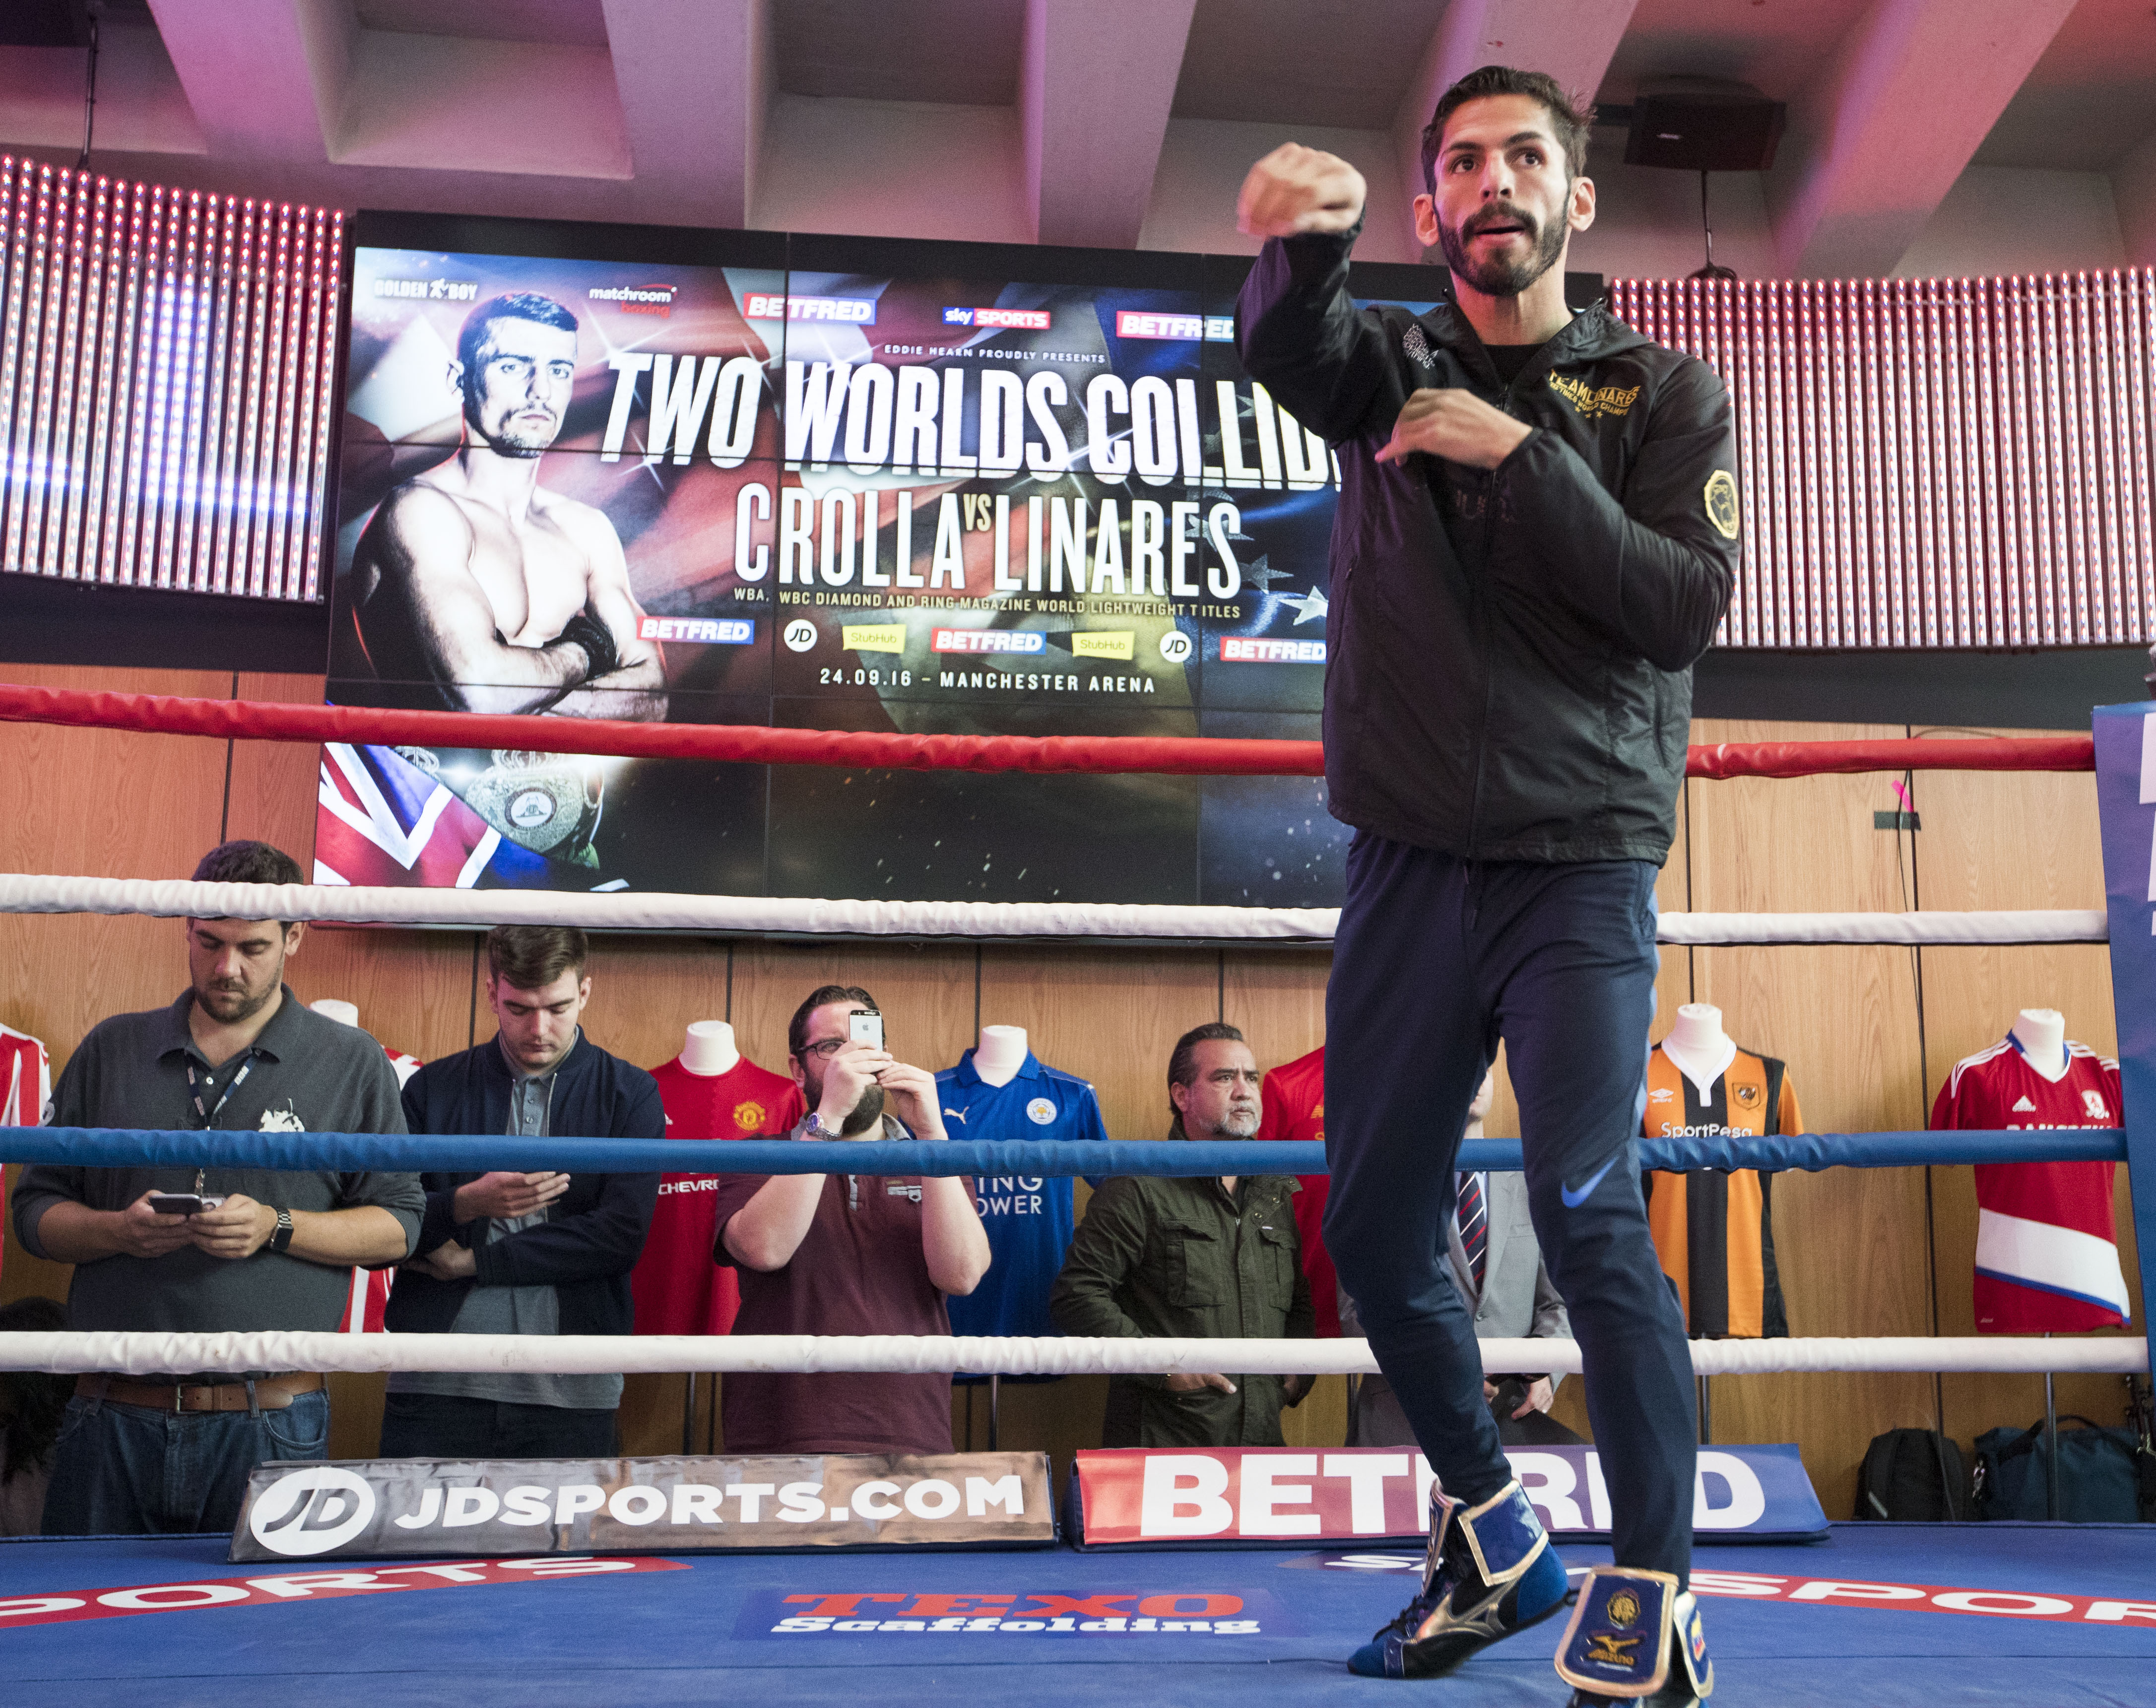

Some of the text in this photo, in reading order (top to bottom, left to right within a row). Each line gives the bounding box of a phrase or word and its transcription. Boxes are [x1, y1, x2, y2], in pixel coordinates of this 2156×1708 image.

[448, 283, 478, 300] BOY
[589, 286, 672, 303] matchroom
[748, 296, 872, 321] BETFRED
[945, 308, 1047, 327] sky SPORTS
[884, 345, 1106, 363] EDDIE HEARN PROUDLY PRESENTS
[600, 352, 1342, 492] TWO WORLDS COLLID
[734, 483, 1241, 599] CROLLA VS LINARES
[779, 591, 810, 604] WBC
[816, 592, 882, 607] DIAMOND
[887, 595, 915, 608] AND
[921, 596, 954, 609] RING
[960, 597, 1031, 611] MAGAZINE
[1037, 599, 1085, 613] WORLD
[1091, 601, 1185, 616] LIGHTWEIGHT
[1191, 604, 1240, 618] TITLES
[640, 618, 751, 642] BETFRED
[789, 625, 812, 643] JD
[850, 631, 897, 644] StubHub
[936, 630, 1043, 654] BETFRED
[1080, 638, 1125, 651] StubHub
[1166, 637, 1187, 654] JD
[1224, 643, 1326, 661] BETFRED
[820, 668, 912, 686] 24.09.16
[940, 672, 1079, 691] MANCHESTER
[1089, 677, 1155, 693] ARENA
[1661, 1121, 1753, 1139] SportPesa
[979, 1177, 1042, 1193] ING
[977, 1195, 1042, 1217] OWER
[394, 1474, 1024, 1529] JDSPORTS.COM
[1140, 1451, 1765, 1537] BETRD
[263, 1489, 360, 1534] JD
[782, 1593, 1244, 1617] TEXO
[771, 1616, 1261, 1635] Scaffolding
